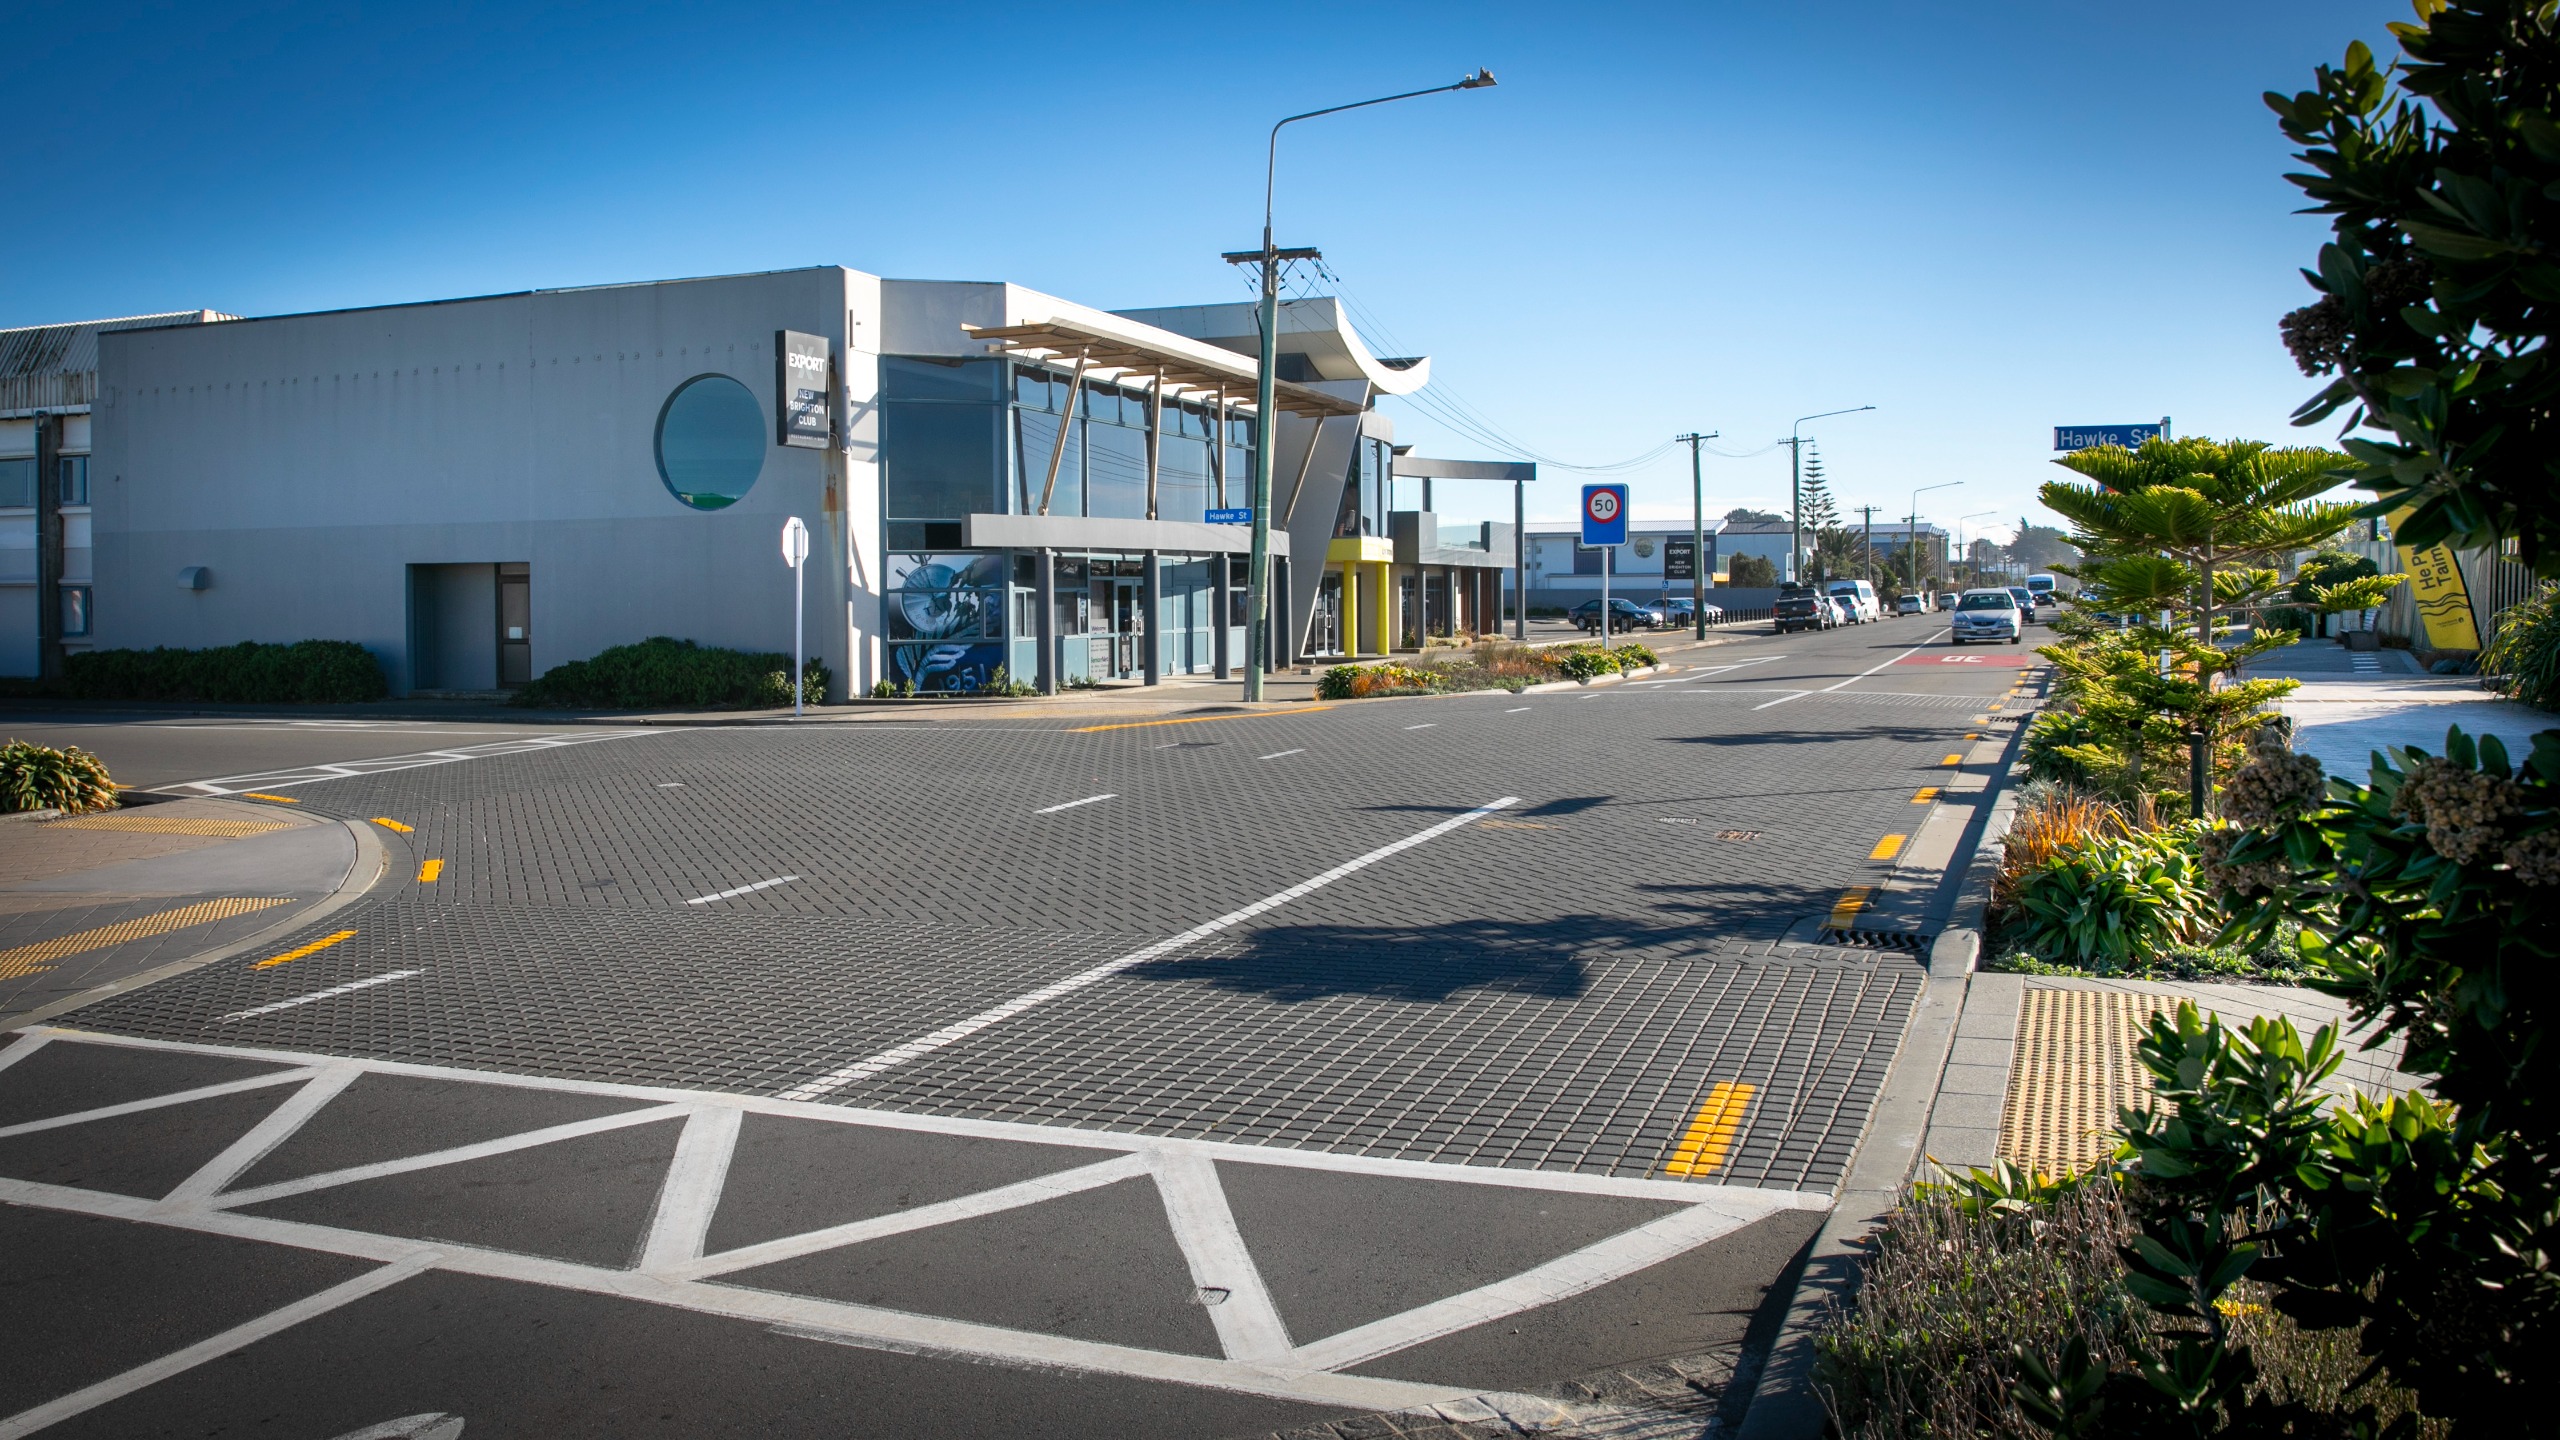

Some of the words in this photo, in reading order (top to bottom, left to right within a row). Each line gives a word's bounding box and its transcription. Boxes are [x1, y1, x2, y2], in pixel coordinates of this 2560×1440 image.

[788, 352, 825, 372] EXPORT
[799, 389, 815, 400] NEW
[789, 400, 825, 415] BRIGHTON
[798, 415, 817, 427] CLUB
[2061, 430, 2118, 447] Hawke
[2130, 428, 2149, 446] St
[1594, 499, 1614, 512] 50
[1209, 512, 1235, 520] Hawke
[1238, 511, 1248, 520] St
[2431, 547, 2452, 587] Taim
[2419, 568, 2436, 591] He
